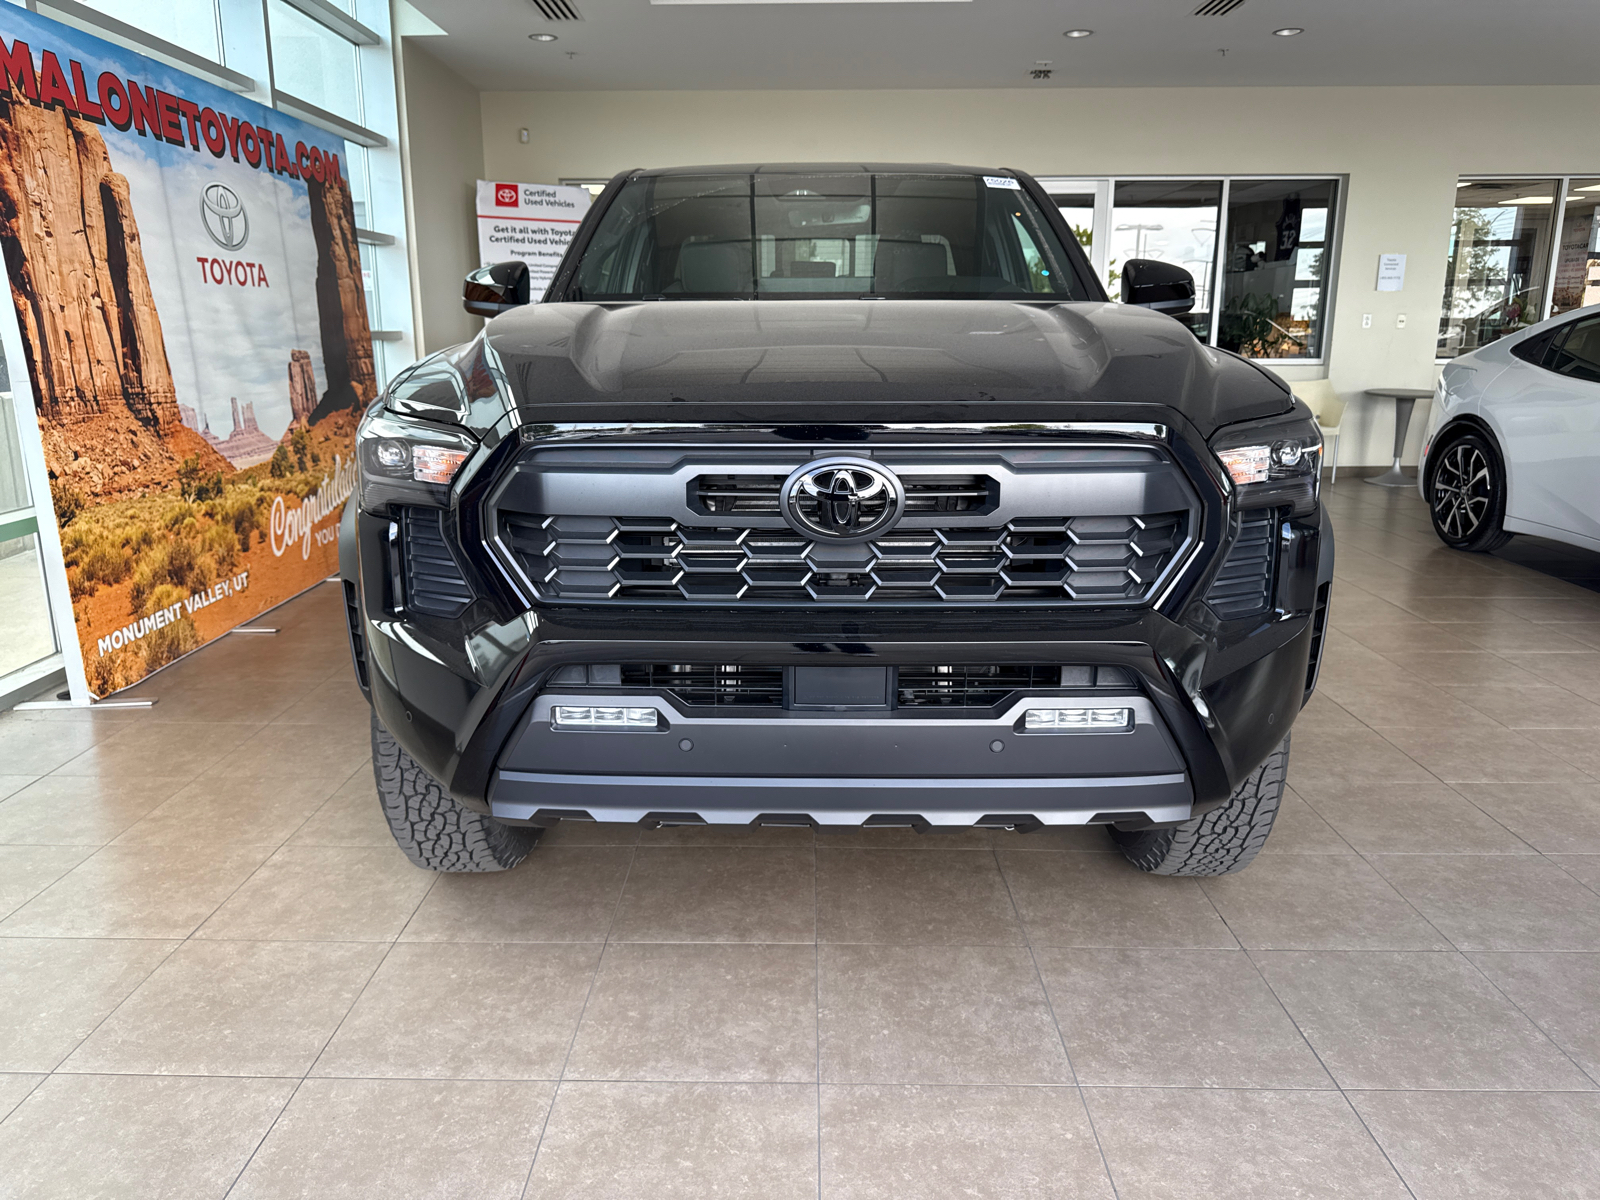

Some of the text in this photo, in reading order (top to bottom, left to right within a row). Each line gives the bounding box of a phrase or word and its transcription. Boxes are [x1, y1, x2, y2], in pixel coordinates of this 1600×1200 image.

[523, 189, 556, 198] Certified
[524, 198, 575, 208] Used Vehicles
[493, 225, 509, 233] Get
[510, 225, 517, 234] it
[519, 226, 529, 234] all
[530, 227, 549, 236] with
[489, 235, 526, 244] Certified
[527, 236, 548, 245] Used
[1280, 229, 1296, 250] 32
[510, 249, 537, 257] Program
[197, 257, 270, 288] TOYOTA
[315, 526, 335, 547] YOU
[97, 572, 249, 657] MONUMENT VALLEY, UT
